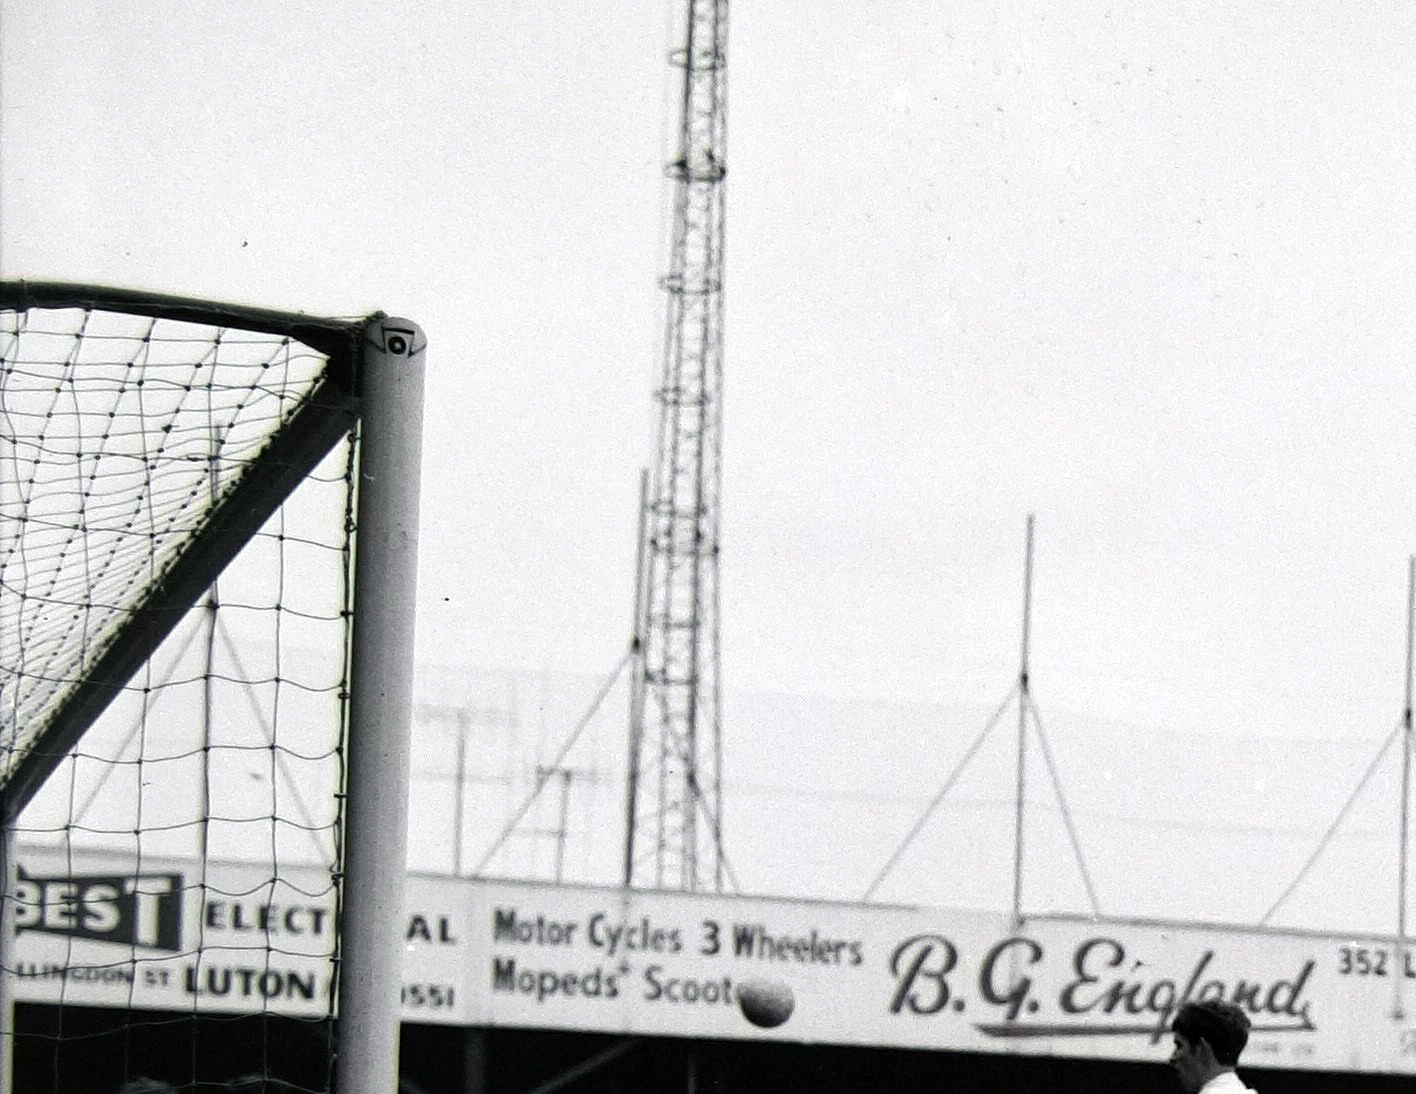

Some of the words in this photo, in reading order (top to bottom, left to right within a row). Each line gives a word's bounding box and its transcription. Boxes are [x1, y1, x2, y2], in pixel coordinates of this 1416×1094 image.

[493, 908, 577, 946] Motor
[588, 913, 683, 956] Cycles
[702, 920, 720, 955] 3
[733, 922, 863, 967] Wheelers
[184, 965, 315, 1000] LUTON
[493, 956, 619, 1001] Mopeds
[1337, 949, 1388, 976] 352
